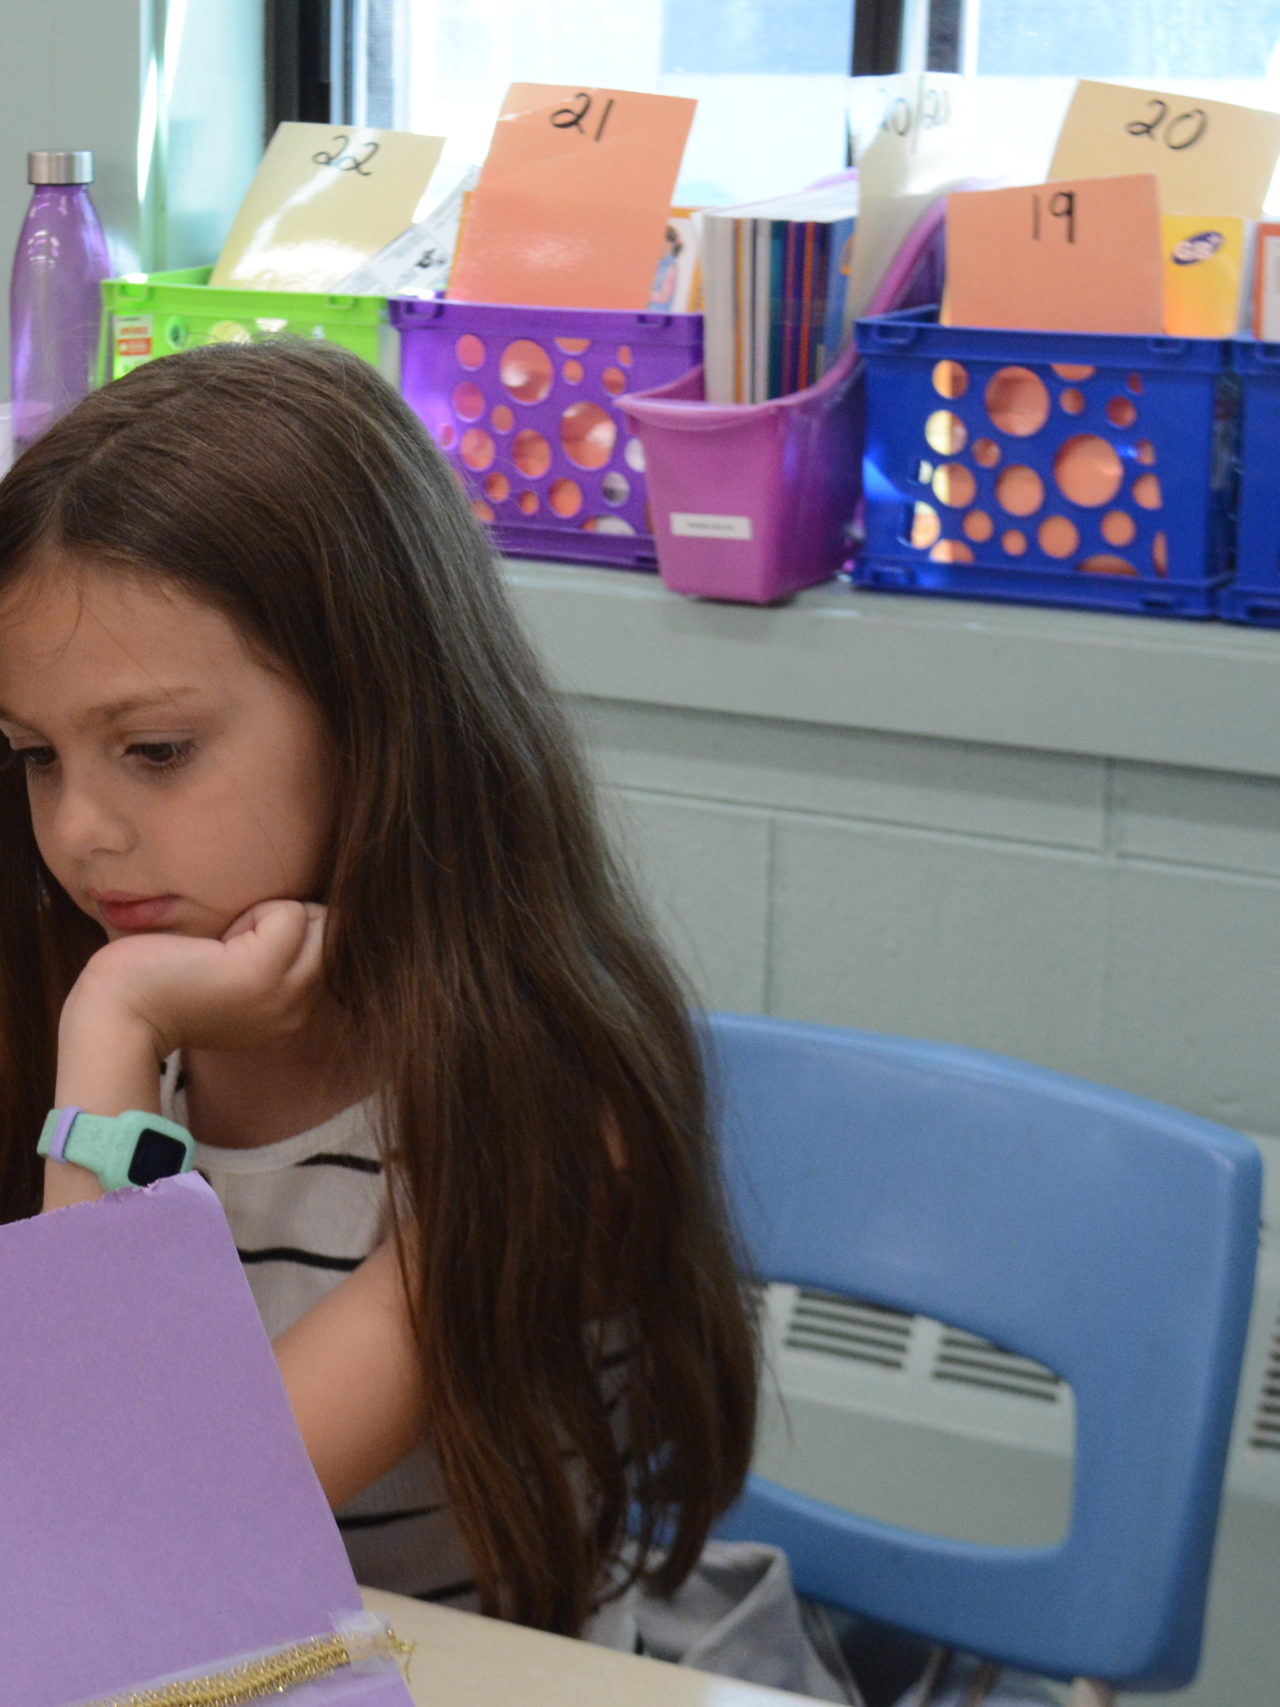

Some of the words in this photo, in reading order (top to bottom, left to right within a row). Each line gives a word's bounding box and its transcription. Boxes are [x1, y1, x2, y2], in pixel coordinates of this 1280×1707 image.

[550, 92, 616, 143] 21
[1125, 98, 1209, 150] 20
[311, 135, 380, 177] 22
[1032, 190, 1076, 245] 19
